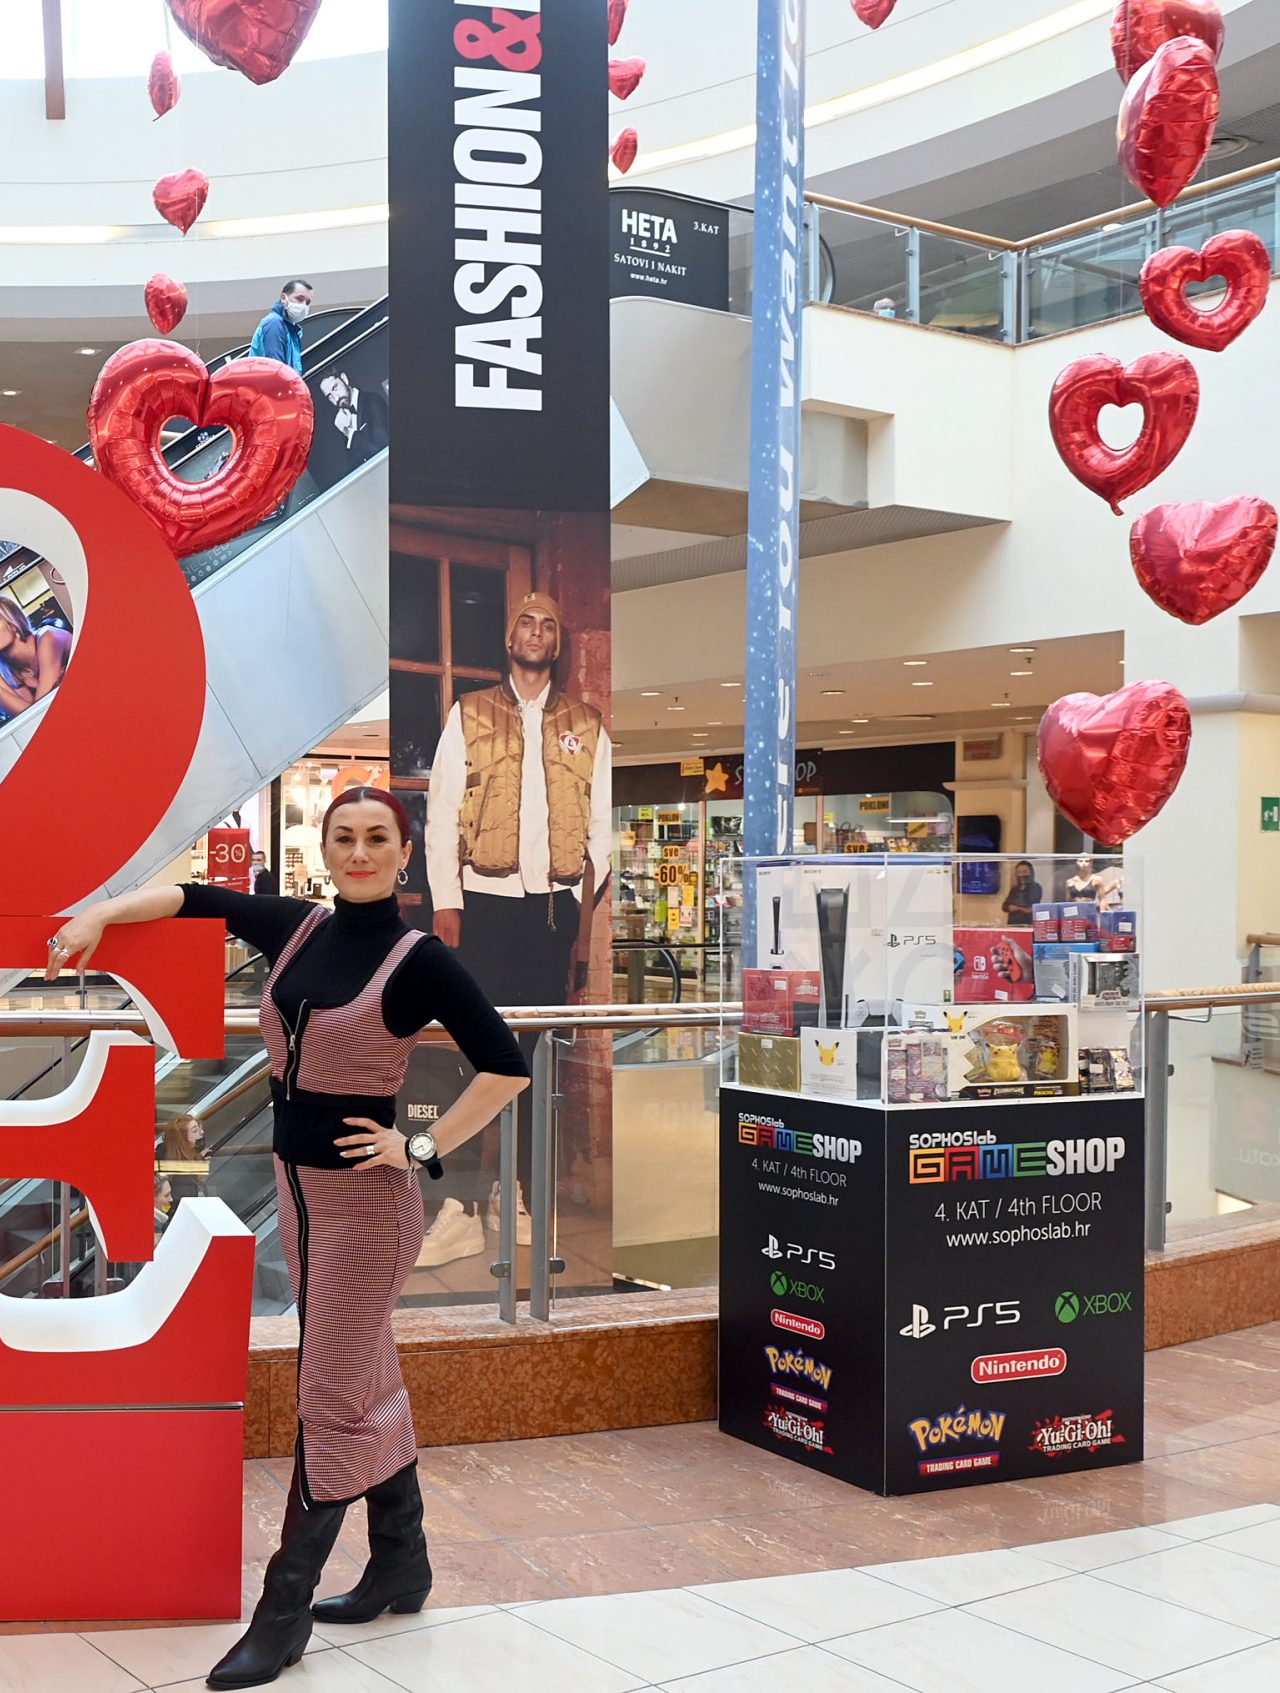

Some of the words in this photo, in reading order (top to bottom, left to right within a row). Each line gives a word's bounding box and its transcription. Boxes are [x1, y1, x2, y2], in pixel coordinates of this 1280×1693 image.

[621, 208, 678, 244] HETA
[614, 253, 649, 269] SATOVI
[651, 260, 655, 270] I
[657, 262, 687, 276] NAKIT
[655, 865, 690, 883] -60%
[407, 1104, 440, 1119] DIESEL
[909, 1130, 997, 1148] SOPHOSlab
[751, 1158, 760, 1171] 4.
[762, 1161, 781, 1174] KAT
[790, 1165, 807, 1180] 4th
[810, 1168, 847, 1187] FLOOR
[758, 1182, 839, 1206] www.sophoslab.hr
[934, 1202, 950, 1222] 4.
[956, 1200, 990, 1220] KAT
[1007, 1197, 1036, 1217] 4th
[1042, 1192, 1102, 1215] FLOOR
[946, 1221, 1091, 1248] www.sophoslab.hr
[787, 1243, 836, 1270] PS5
[789, 1279, 825, 1304] XBOX
[1082, 1291, 1132, 1316] XBOX
[774, 1312, 821, 1335] Nintendo
[943, 1300, 1021, 1330] PS5
[978, 1354, 1060, 1376] Nintendo
[1042, 1443, 1072, 1453] TRADING
[1072, 1440, 1091, 1449] CARD
[1092, 1437, 1112, 1446] GAME
[926, 1461, 954, 1473] TRADING
[955, 1458, 972, 1470] CARD
[973, 1456, 992, 1468] GAME
